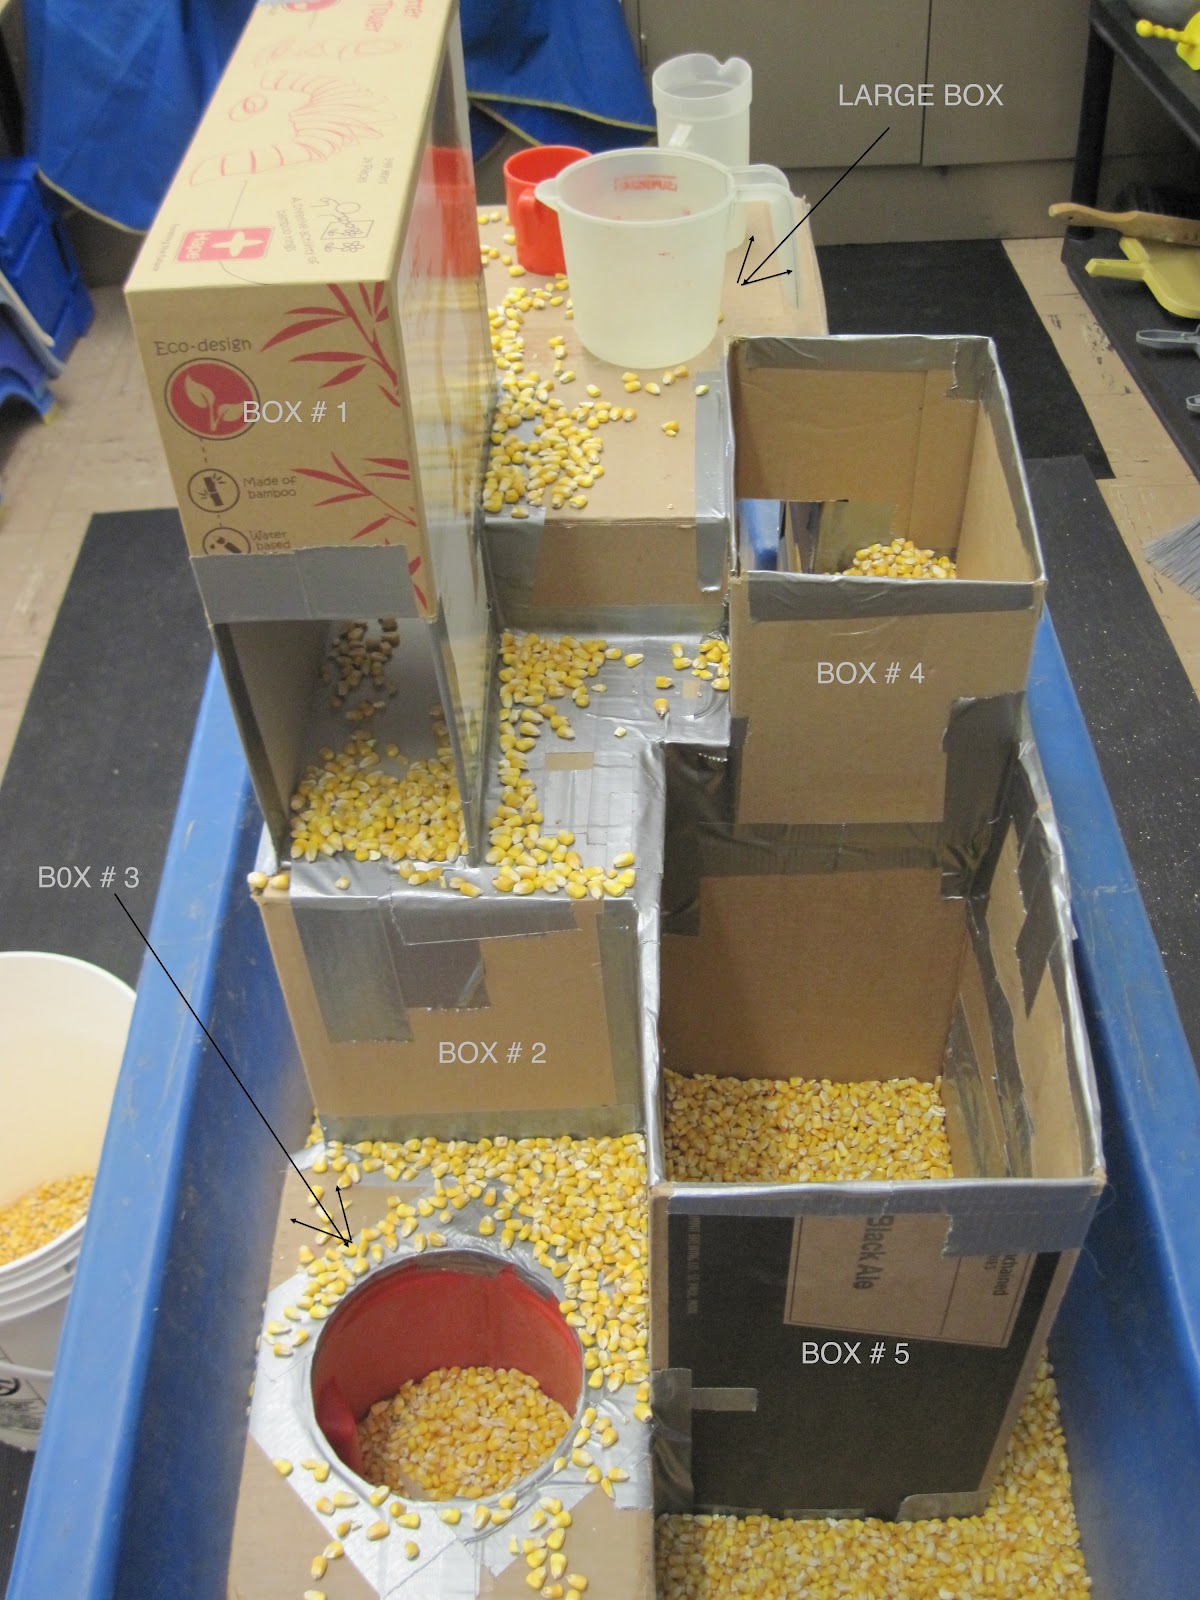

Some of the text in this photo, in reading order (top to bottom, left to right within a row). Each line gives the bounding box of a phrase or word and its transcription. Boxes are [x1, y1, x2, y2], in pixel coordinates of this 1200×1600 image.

[185, 231, 211, 262] Hape
[153, 338, 252, 356] Eco-design
[243, 476, 297, 487] Made of
[248, 489, 297, 499] bamboo
[249, 530, 287, 541] Water
[256, 540, 291, 551] based
[852, 1214, 895, 1290] Black Ale
